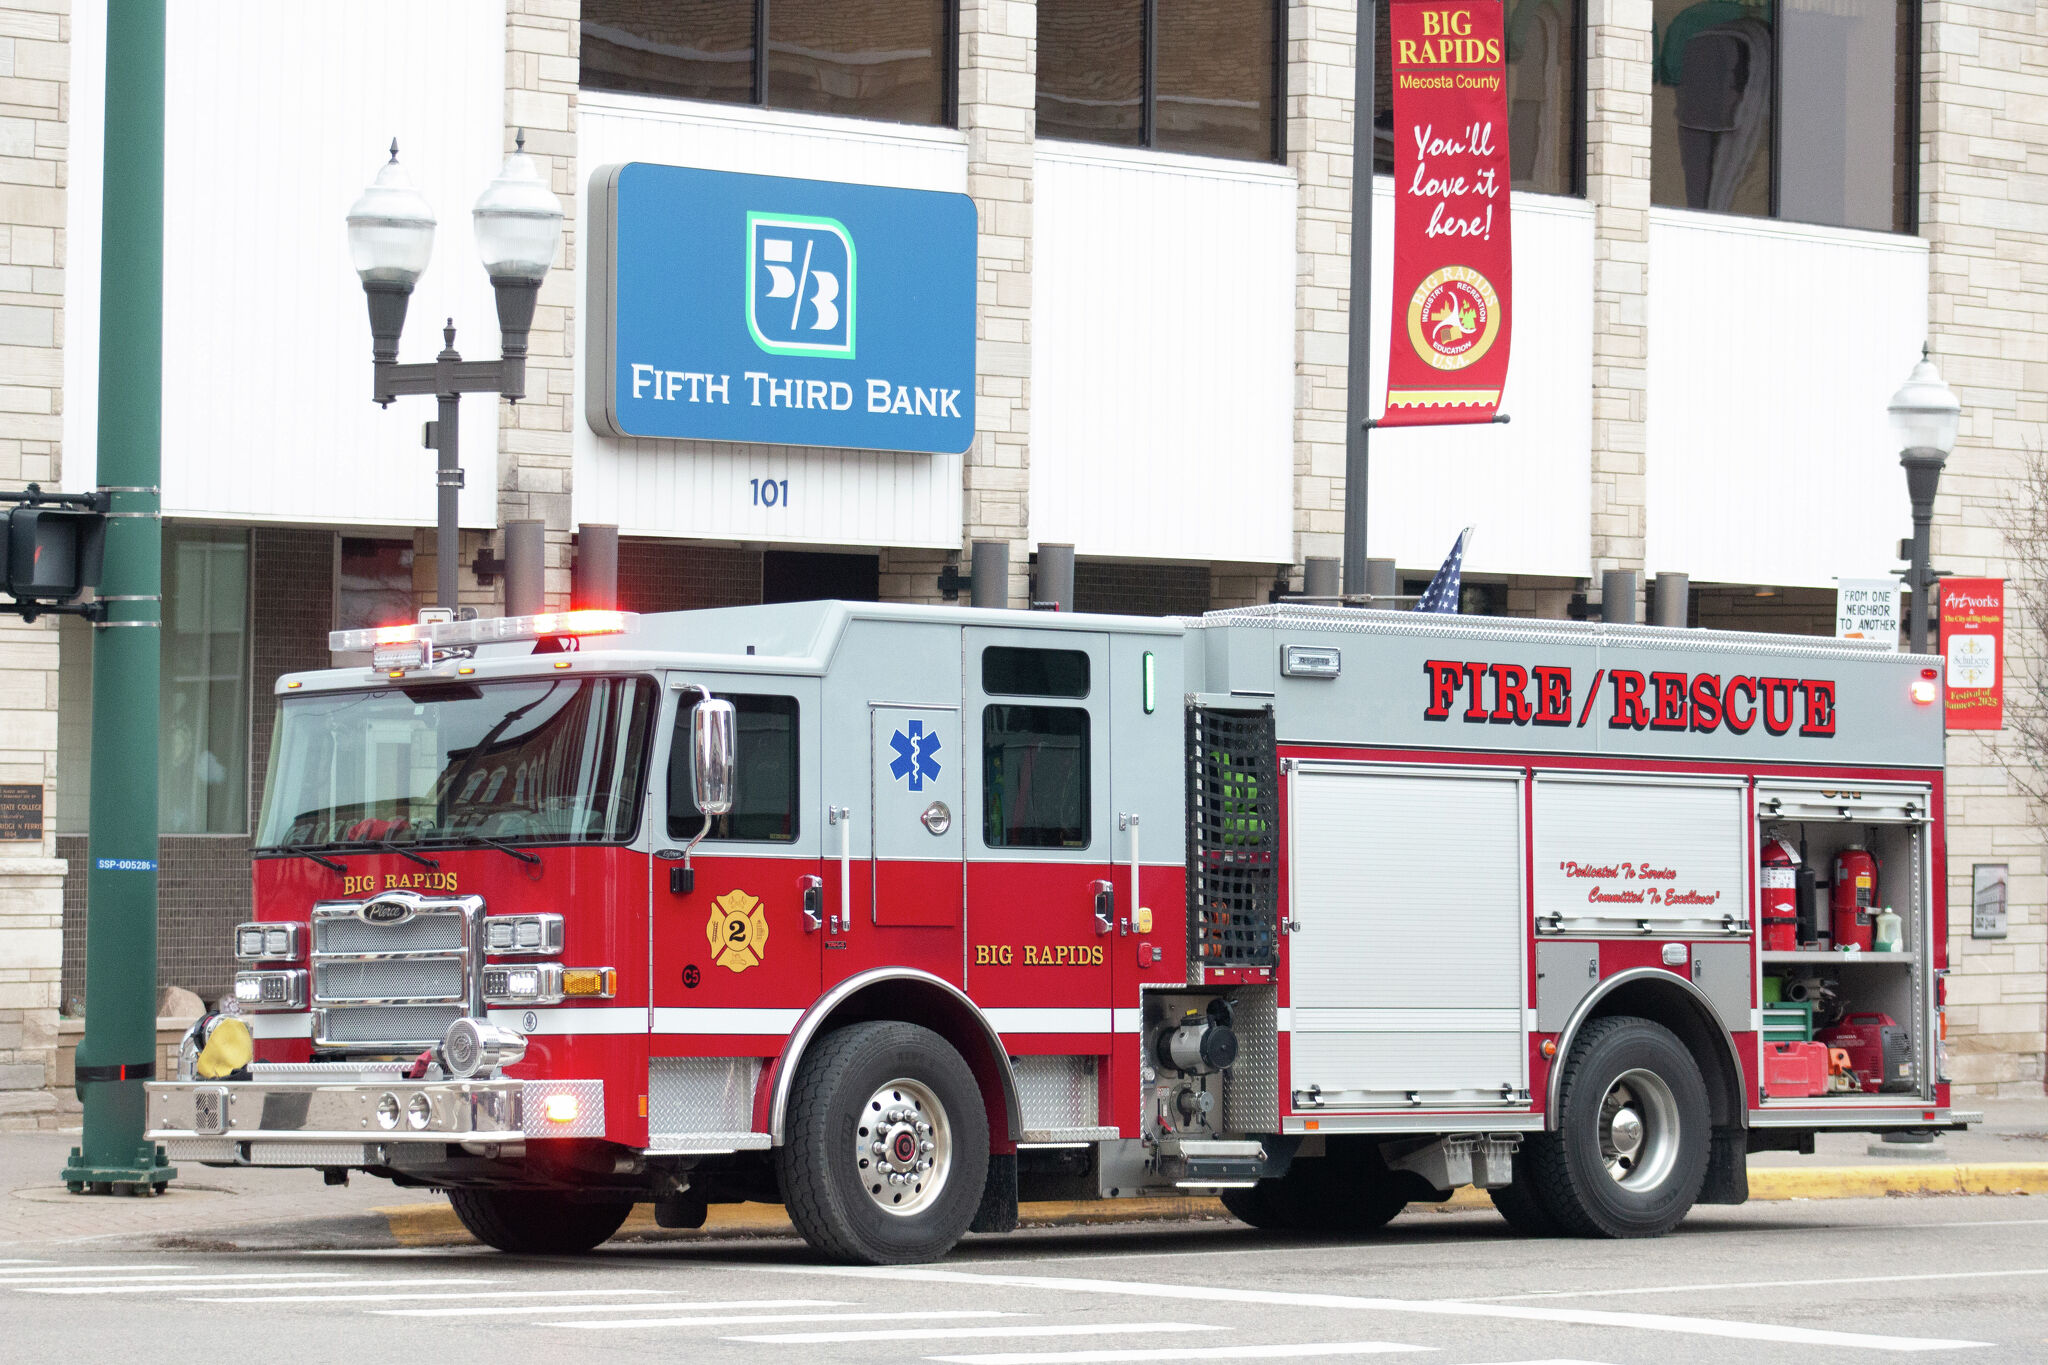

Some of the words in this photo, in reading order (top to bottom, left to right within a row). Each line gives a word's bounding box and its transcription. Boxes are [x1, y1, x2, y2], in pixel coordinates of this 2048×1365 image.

[1422, 10, 1472, 36] BIG
[1398, 38, 1500, 64] RAPIDS
[1400, 75, 1453, 89] Mecosta
[1456, 74, 1500, 92] County
[1414, 122, 1495, 160] You'll
[1408, 162, 1469, 198] love
[1472, 168, 1499, 198] it
[1425, 202, 1492, 240] here!
[1412, 275, 1437, 307] BIG
[1441, 266, 1498, 307] RAPIDS
[1422, 285, 1444, 323] INDUSTRY
[1456, 282, 1486, 323] RECREATION
[1432, 341, 1472, 354] EDUCATION
[750, 478, 789, 508] 101
[1844, 590, 1868, 602] FROM
[1872, 591, 1891, 602] ONE
[1846, 604, 1890, 616] NEIGHBOR
[1840, 618, 1853, 630] TO
[1858, 619, 1896, 631] ANOTHER
[1951, 689, 1981, 701] Festival
[99, 859, 151, 870] SSP-005286
[1621, 862, 1636, 879] To
[1638, 863, 1677, 880] Service
[343, 875, 375, 896] BIG
[384, 872, 458, 892] RAPIDS
[1588, 886, 1644, 903] Committed
[1647, 888, 1661, 904] To
[729, 920, 746, 942] 2
[975, 945, 1013, 966] BIG
[1023, 945, 1104, 966] RAPIDS
[684, 970, 699, 984] C5
